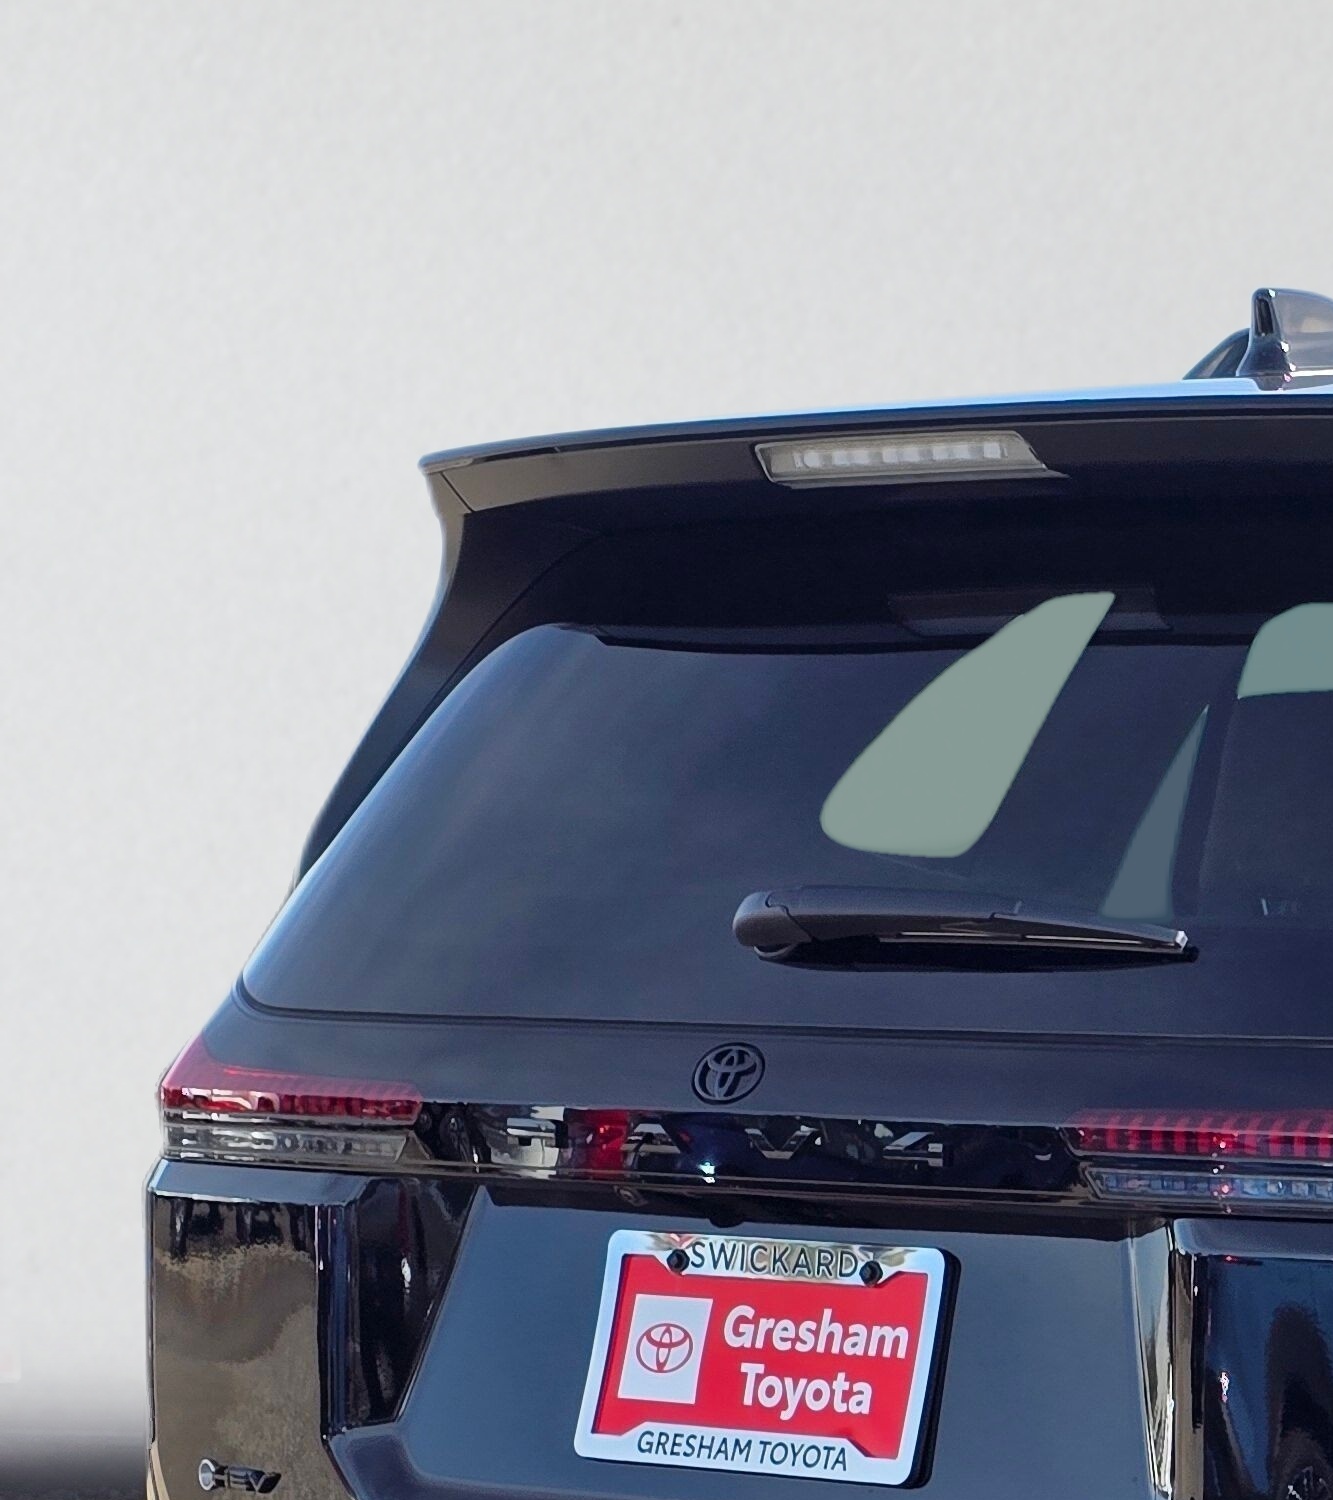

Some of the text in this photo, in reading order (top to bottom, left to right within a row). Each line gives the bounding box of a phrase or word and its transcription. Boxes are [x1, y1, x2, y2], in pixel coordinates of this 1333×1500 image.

[690, 1240, 859, 1279] SWICKARD
[723, 1305, 909, 1359] Gresham
[740, 1363, 873, 1421] Toyota
[637, 1430, 849, 1472] GRESHAM TOYOTA
